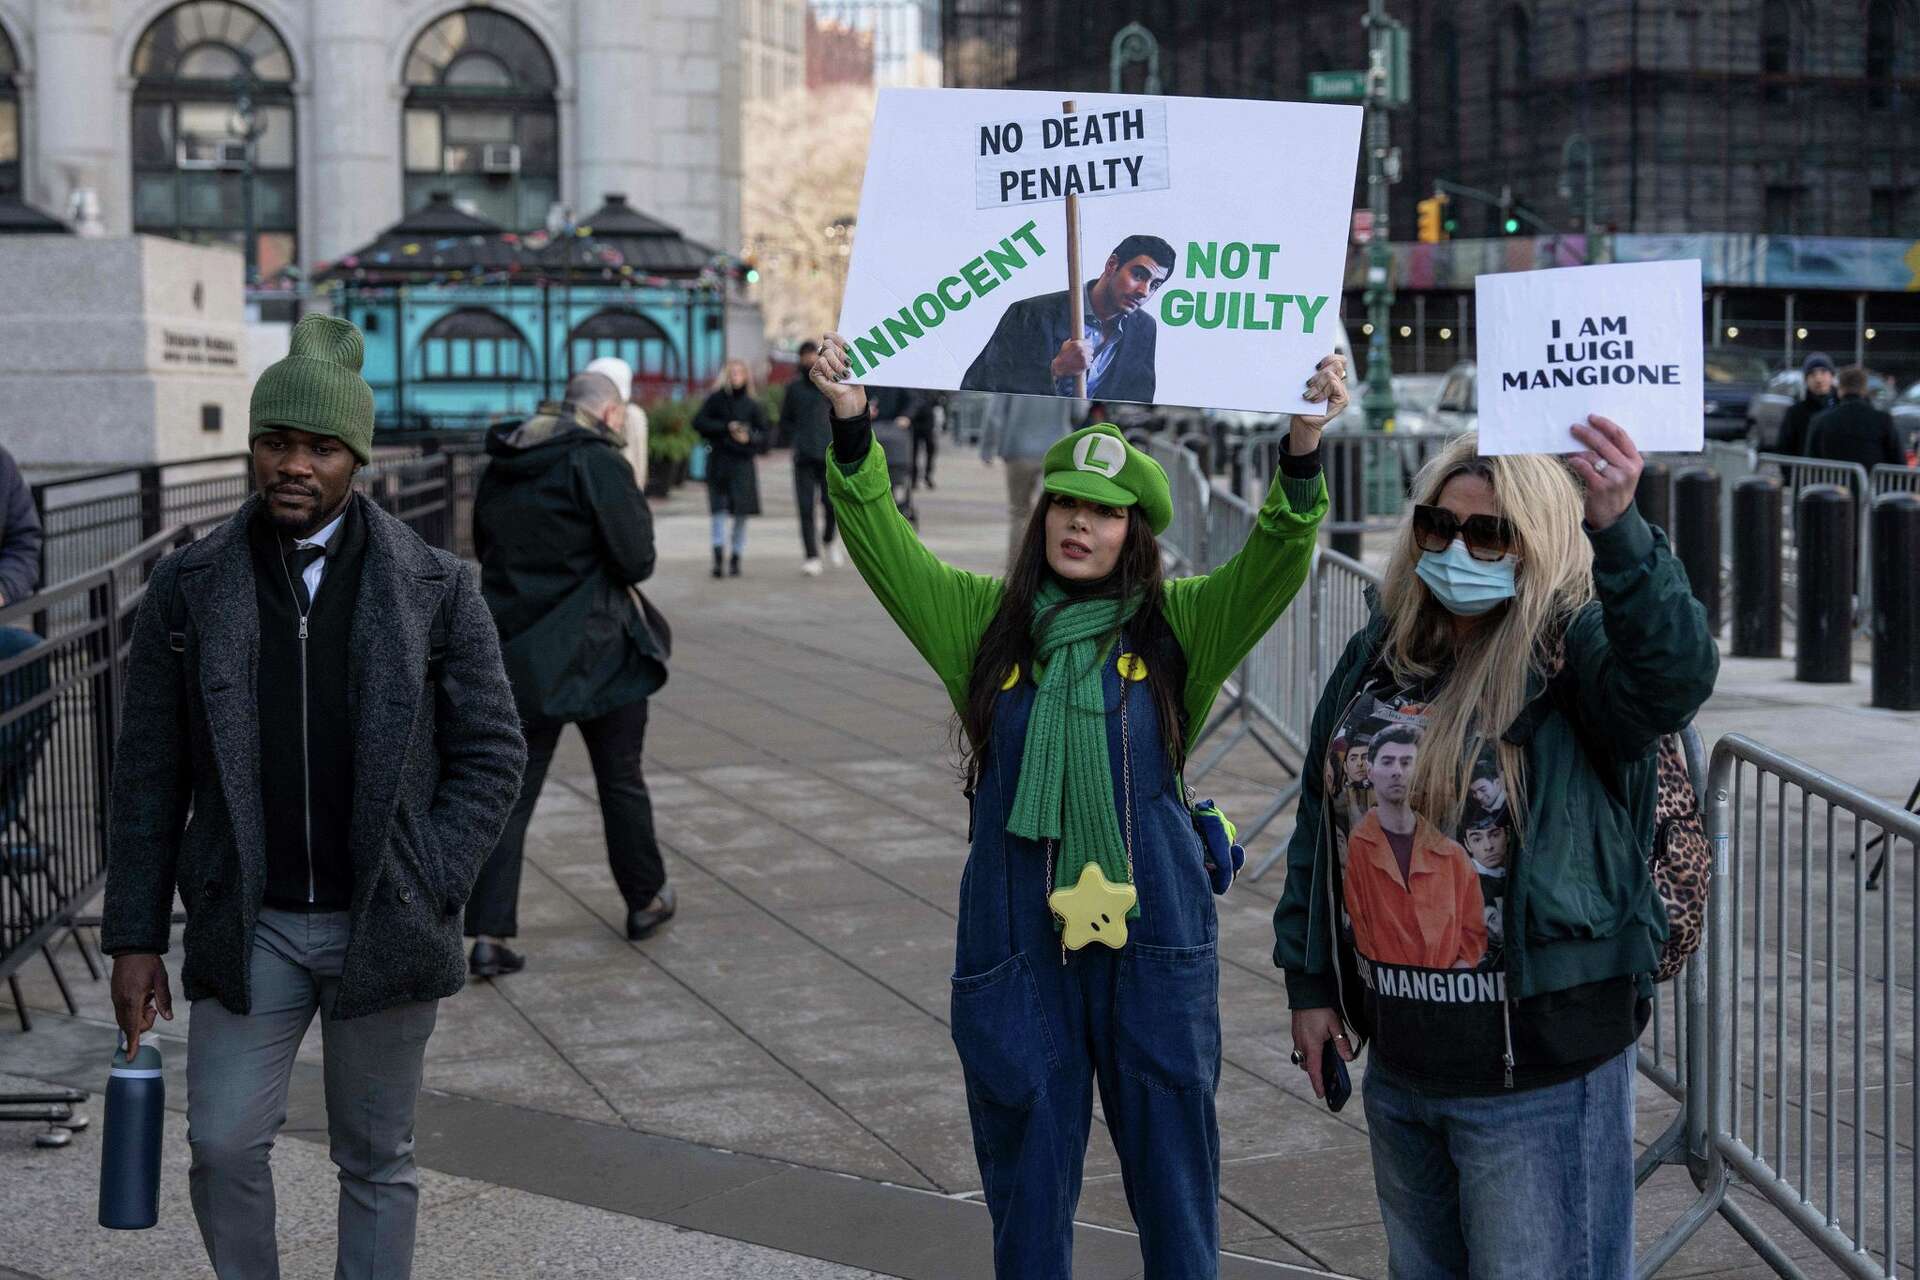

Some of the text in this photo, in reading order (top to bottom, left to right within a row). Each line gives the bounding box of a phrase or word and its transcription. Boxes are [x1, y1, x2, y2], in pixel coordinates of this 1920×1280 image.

[980, 108, 1144, 156] NO DEATH
[1000, 155, 1144, 202] PENALTY
[1186, 242, 1280, 280] NOT
[847, 219, 1047, 378] INNOCENT
[1160, 289, 1329, 334] GUILTY
[1551, 316, 1627, 339] I AM
[1547, 340, 1634, 364] LUIGI
[1502, 364, 1681, 392] MANGIONE
[1083, 436, 1110, 470] L
